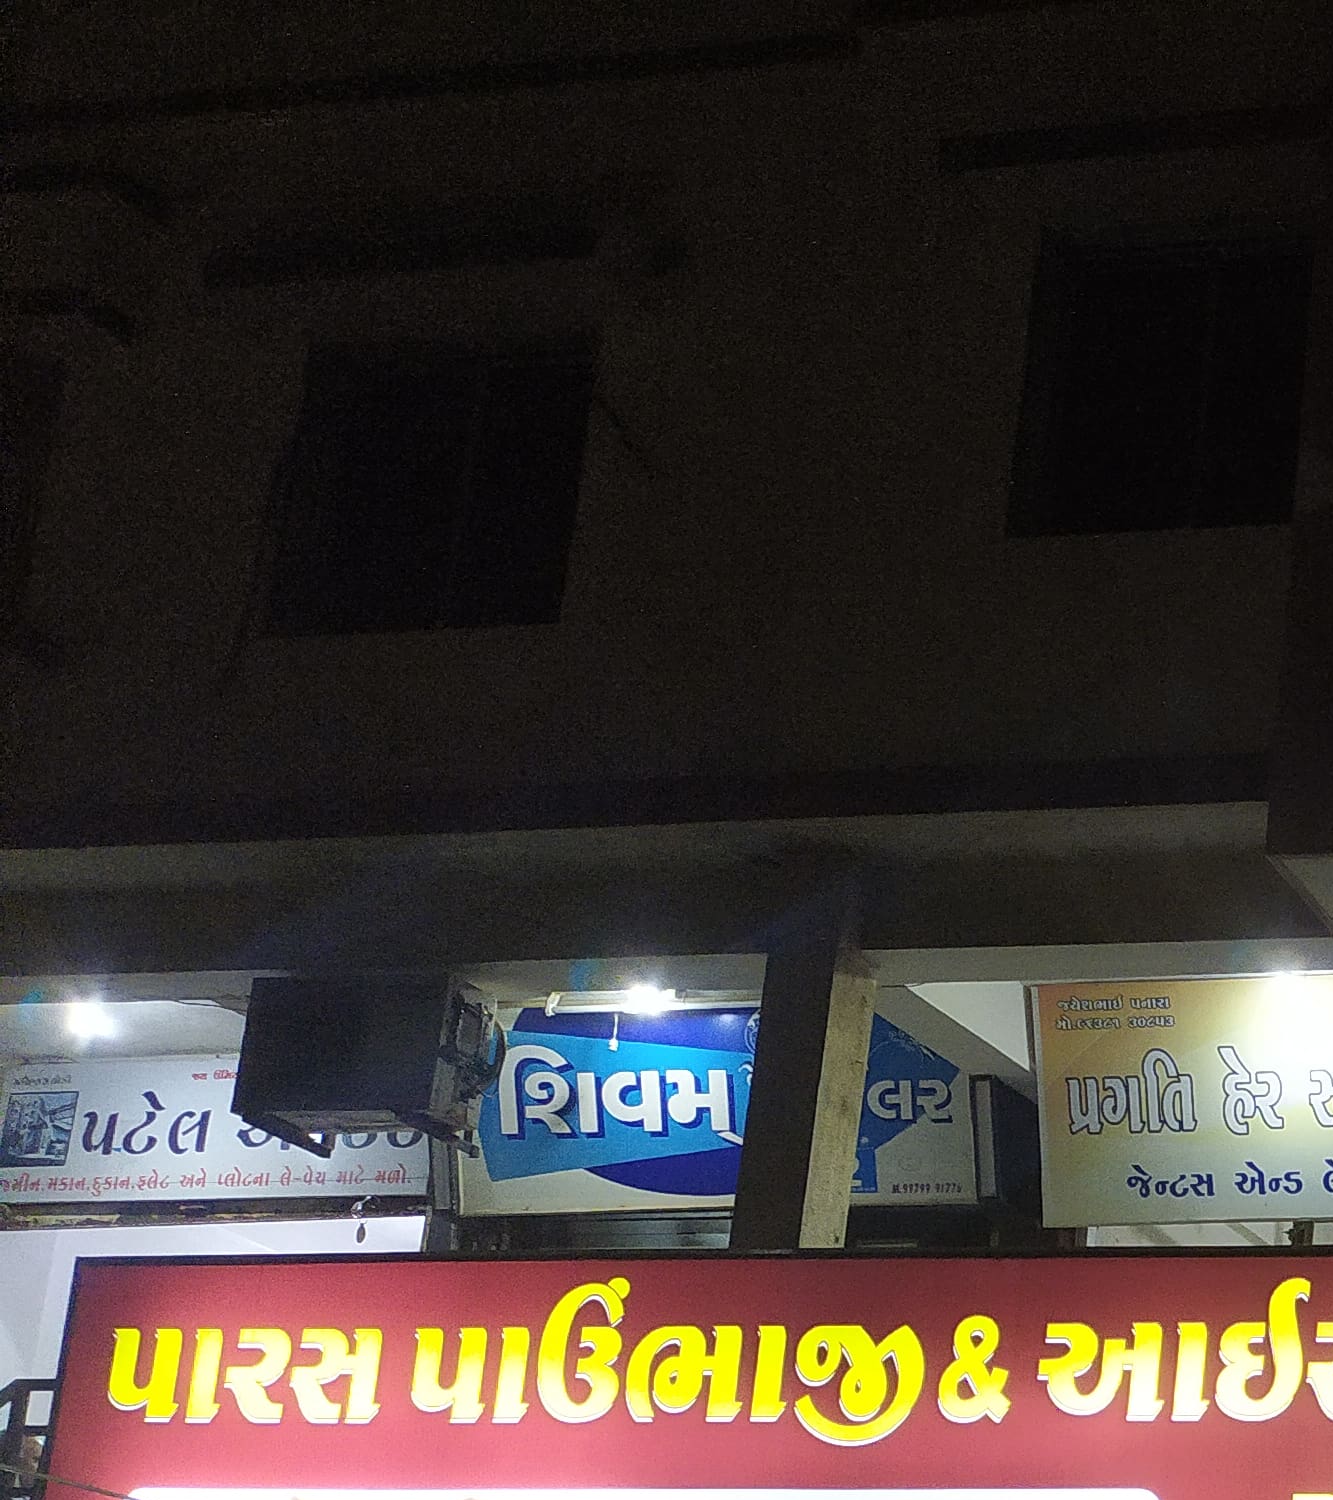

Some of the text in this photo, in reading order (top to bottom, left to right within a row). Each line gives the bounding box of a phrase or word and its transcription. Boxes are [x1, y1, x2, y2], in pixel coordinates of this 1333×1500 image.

[82, 1090, 213, 1156] પટેલ
[1066, 1047, 1198, 1135] પ્રગતિ
[1217, 1045, 1285, 1136] હેર
[180, 1168, 207, 1188] અને
[1234, 1160, 1304, 1196] એન્ડ
[107, 1326, 383, 1425] પારસ
[937, 1315, 1011, 1425] &
